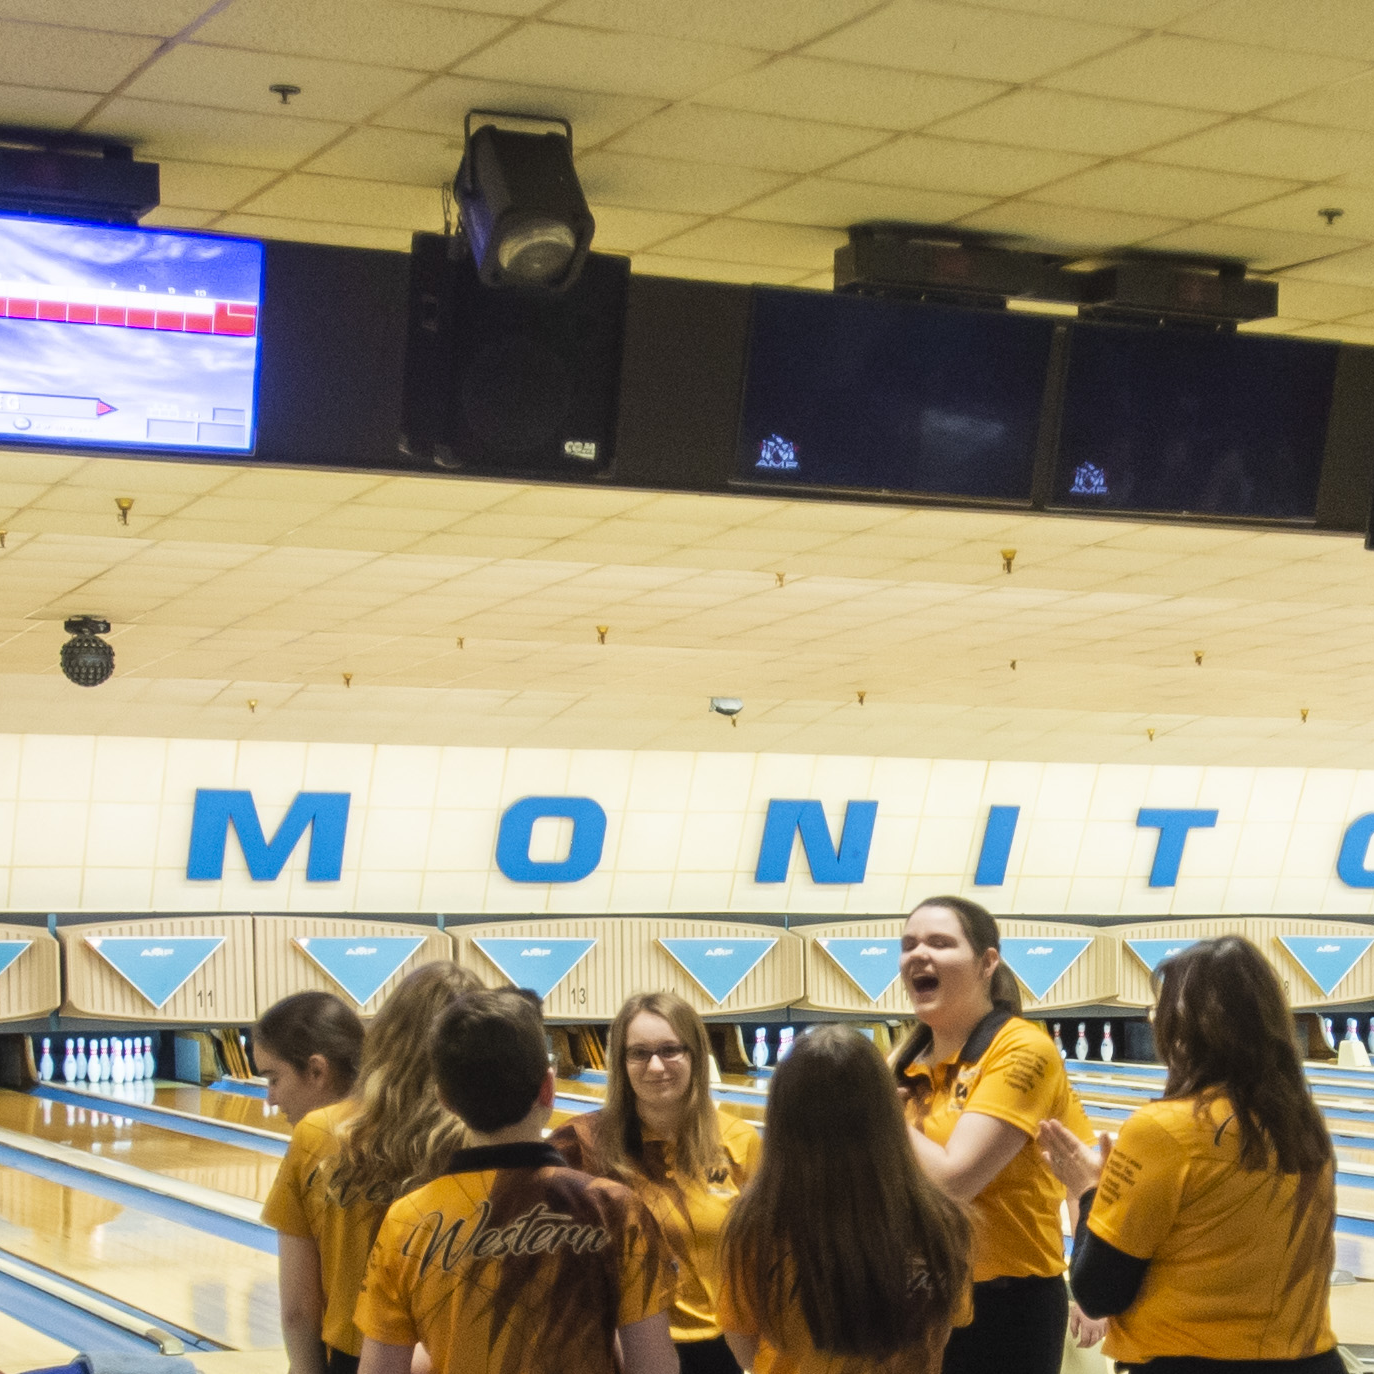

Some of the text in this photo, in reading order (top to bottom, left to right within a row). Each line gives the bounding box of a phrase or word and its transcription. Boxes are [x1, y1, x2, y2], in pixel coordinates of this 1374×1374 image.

[140, 947, 175, 957] AMF
[345, 946, 378, 955] AMF
[520, 947, 552, 957] AMF
[705, 947, 734, 956] AMF
[860, 946, 887, 956] AMF
[1026, 946, 1053, 955] AMF
[197, 990, 214, 1008] 11
[571, 988, 587, 1005] 13
[401, 1200, 612, 1278] Western
